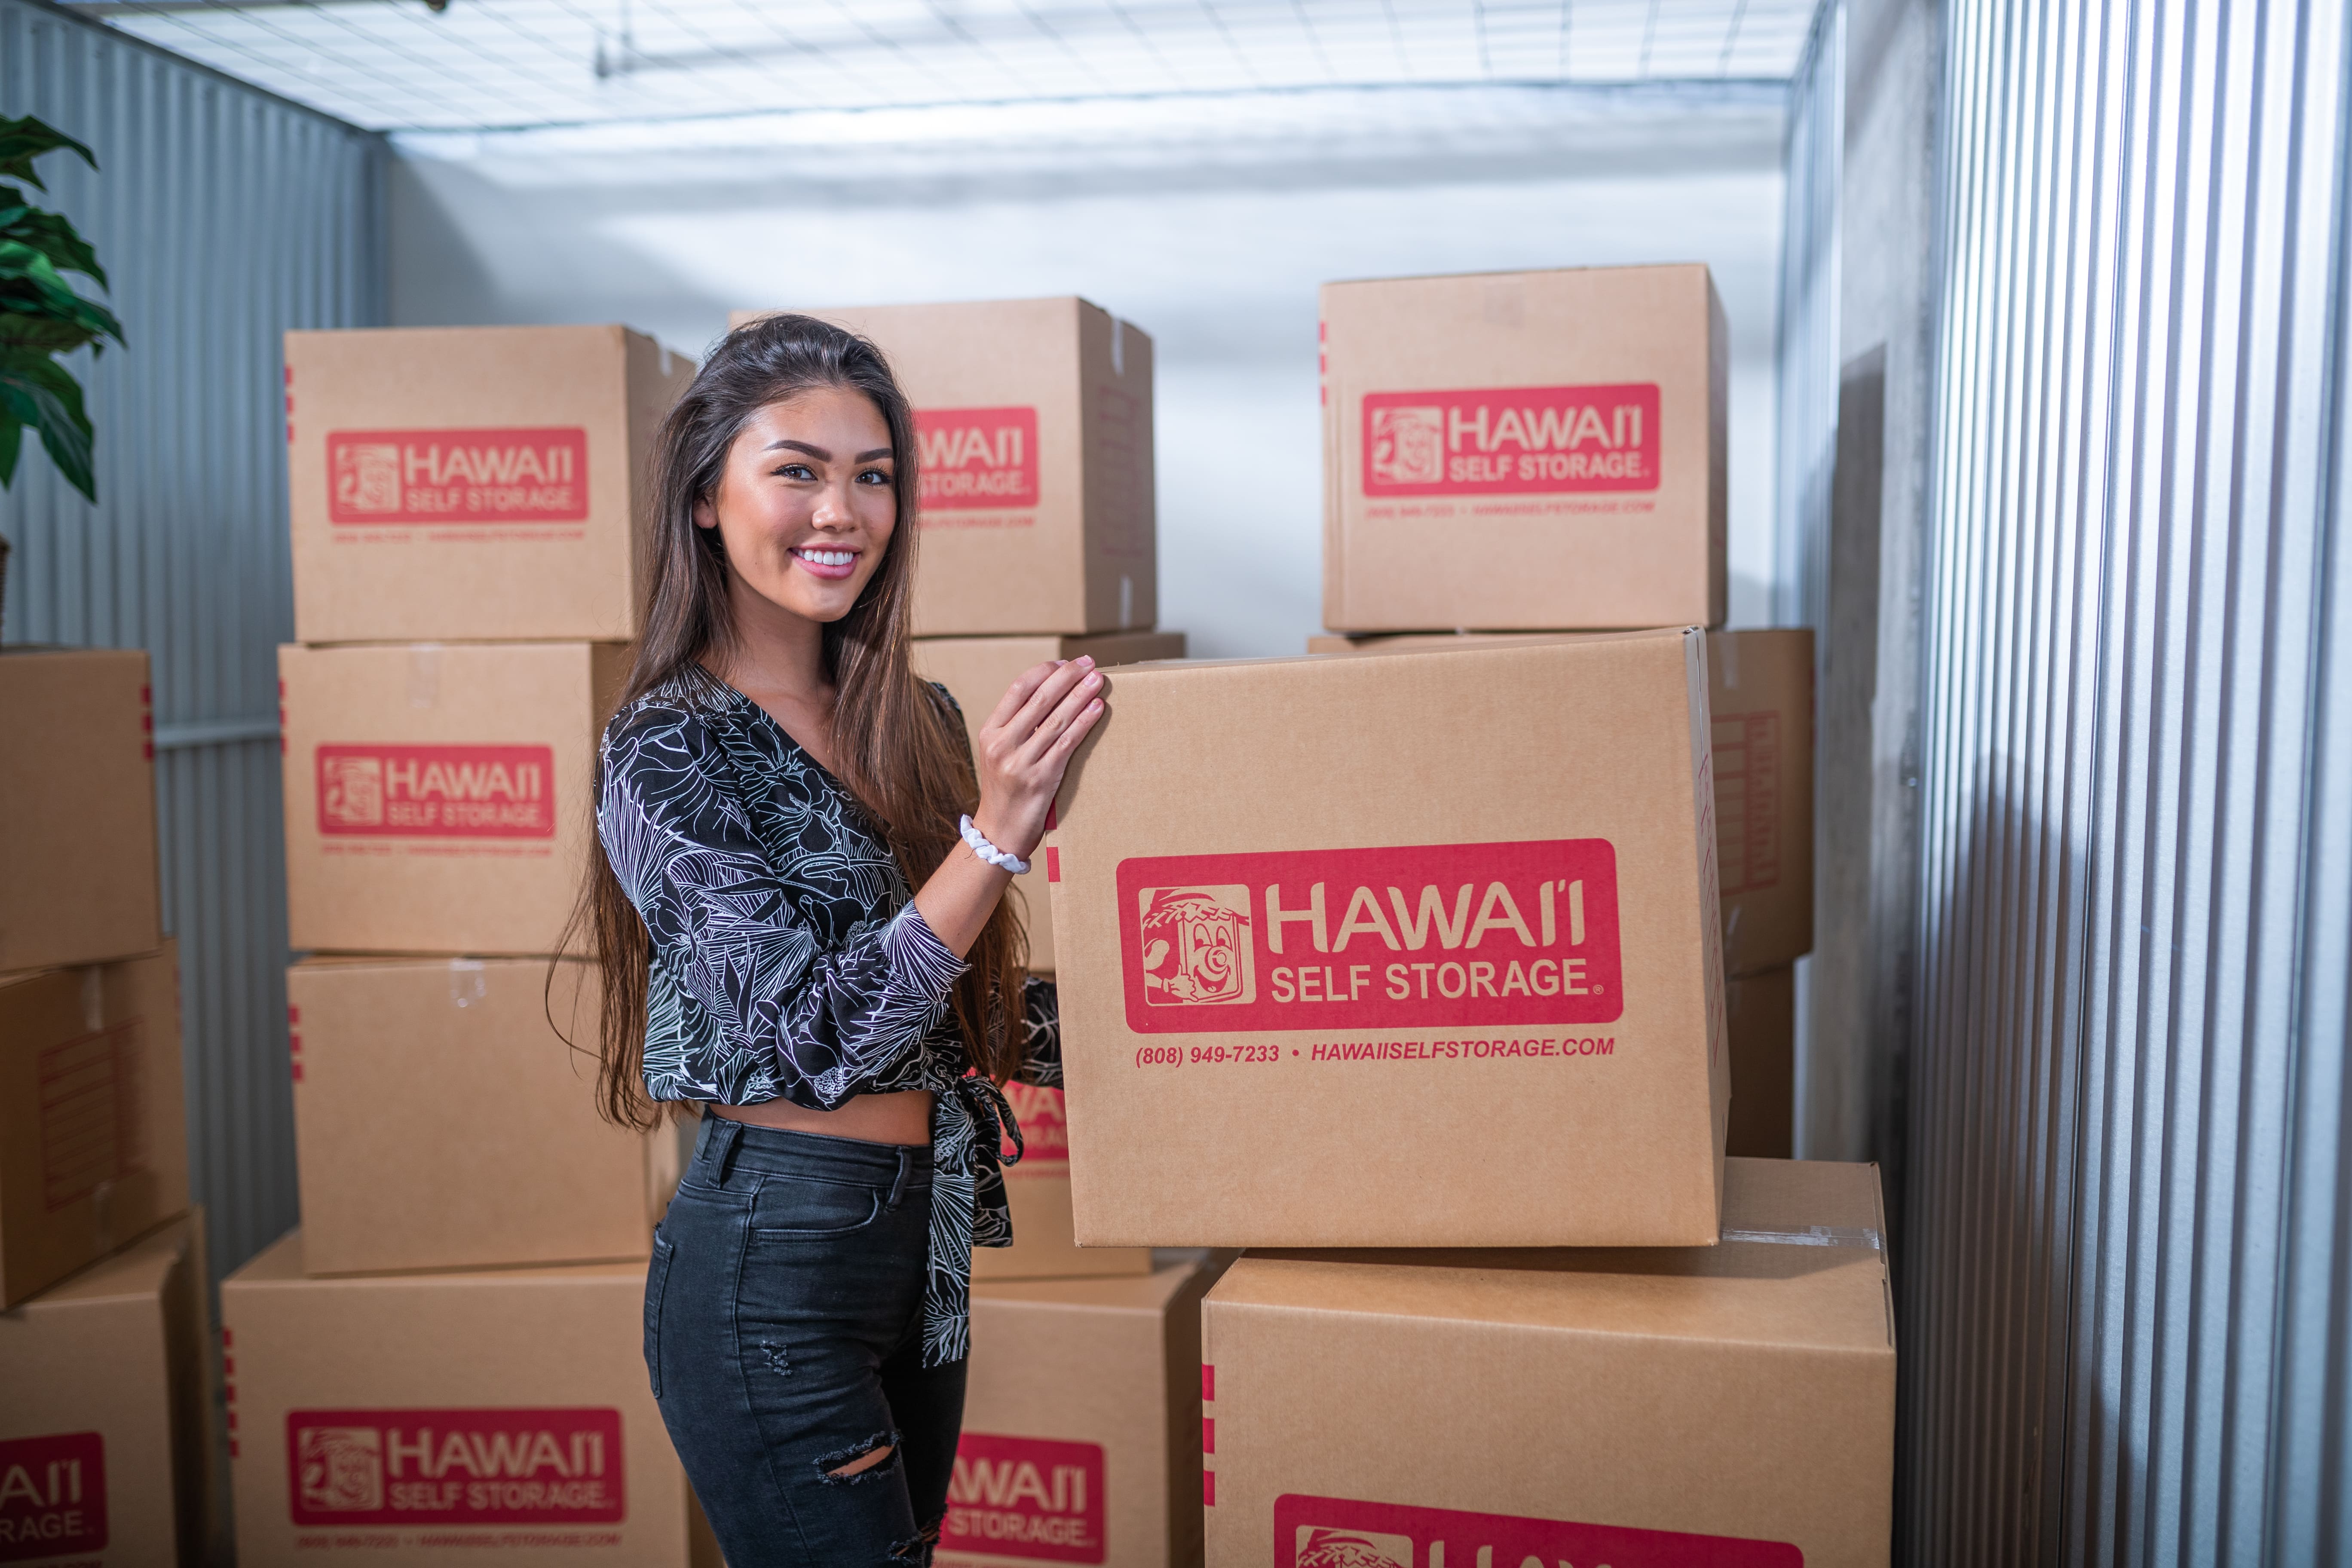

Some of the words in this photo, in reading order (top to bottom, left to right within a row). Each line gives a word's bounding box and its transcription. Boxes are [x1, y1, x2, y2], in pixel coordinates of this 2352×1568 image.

[1449, 455, 1512, 482] SELF
[406, 487, 460, 512] SELF
[388, 801, 437, 827] SELF
[1271, 965, 1371, 1002] SELF
[1136, 1047, 1183, 1068] (808)
[1190, 1044, 1280, 1063] 949-7233
[1311, 1037, 1615, 1061] HAWAIISELFSTORAGE.COM
[389, 1481, 461, 1510] SELF
